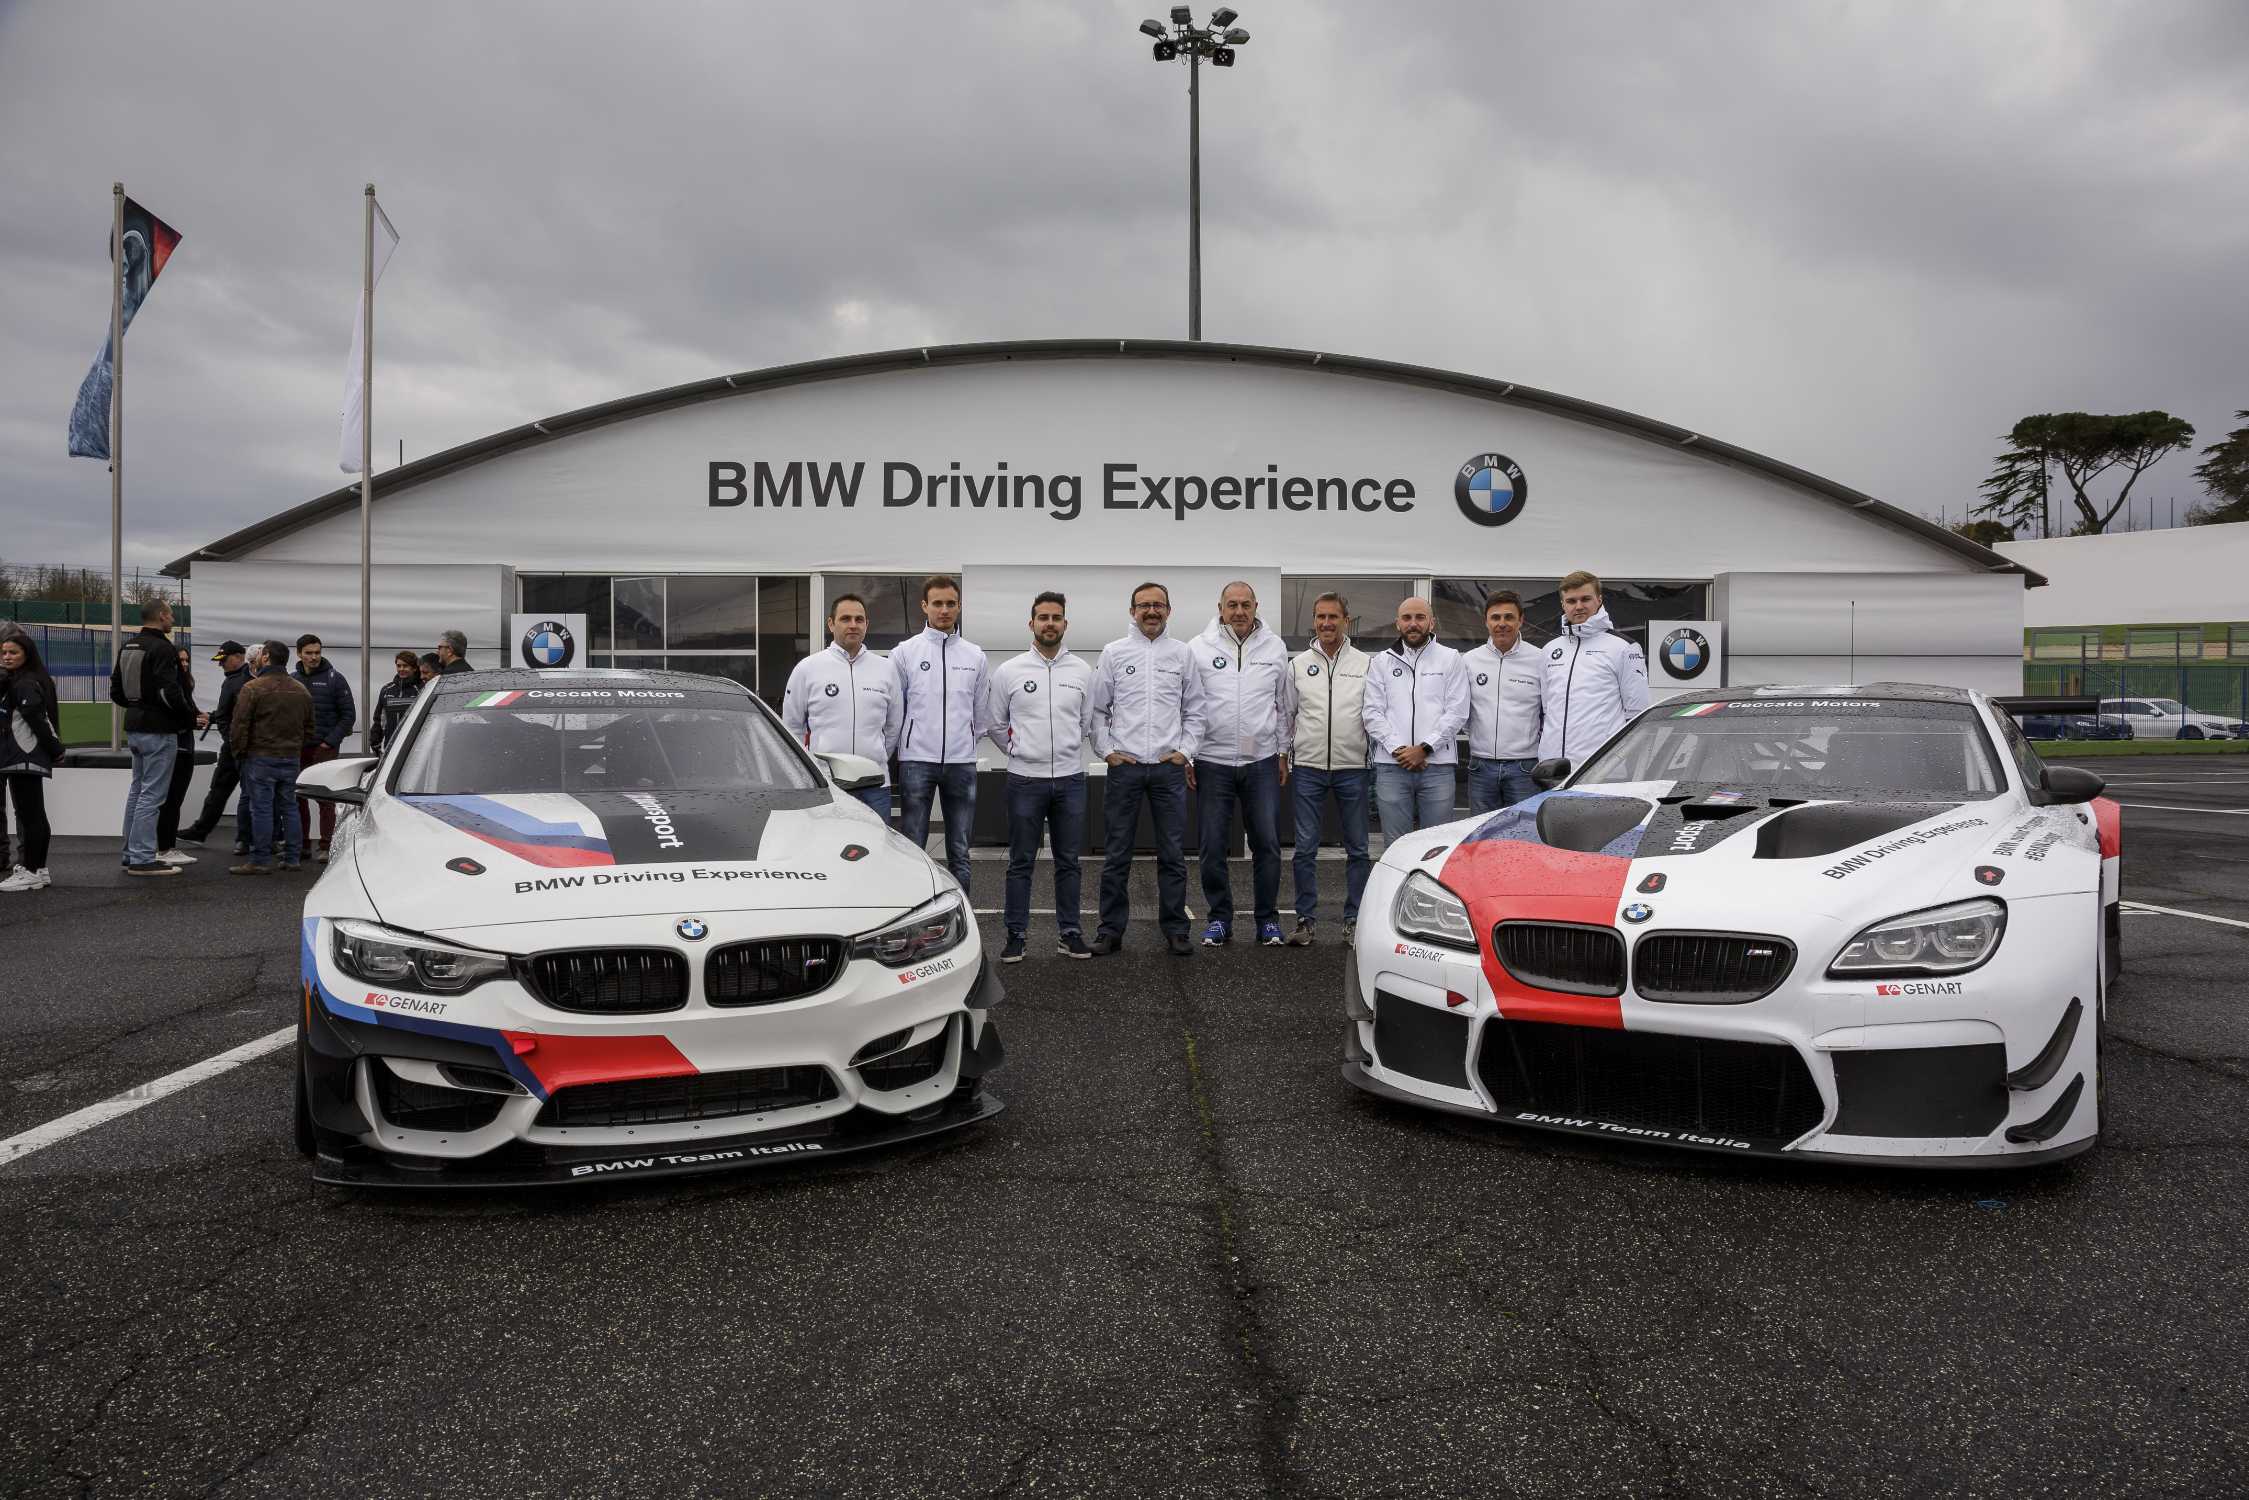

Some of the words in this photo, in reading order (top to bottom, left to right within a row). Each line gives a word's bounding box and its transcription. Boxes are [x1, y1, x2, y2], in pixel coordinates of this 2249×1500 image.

[1461, 455, 1522, 480] BMW
[708, 461, 865, 507] BMW
[883, 461, 1083, 521] Driving
[1103, 463, 1416, 520] Experience
[526, 622, 570, 640] BMW
[1664, 629, 1707, 647] BMW
[528, 690, 612, 698] Ceccato
[617, 690, 685, 698] Motors
[1727, 701, 1805, 709] Ceccato
[1811, 700, 1881, 708] Motors
[1821, 854, 1873, 880] BMW
[1863, 837, 1927, 859] Driving
[1911, 818, 1990, 839] Experience
[514, 876, 586, 893] BMW
[593, 871, 685, 886] Driving
[691, 868, 828, 881] Experience
[1408, 946, 1444, 962] GENART
[915, 958, 956, 978] GENART
[1903, 982, 1962, 995] GENART
[389, 996, 448, 1015] GENART
[1515, 1112, 1594, 1127] BMW
[1598, 1122, 1671, 1138] Team
[1677, 1133, 1751, 1150] Italia
[571, 1158, 654, 1177] BMW
[660, 1149, 744, 1165] Team
[749, 1143, 823, 1156] Italia
